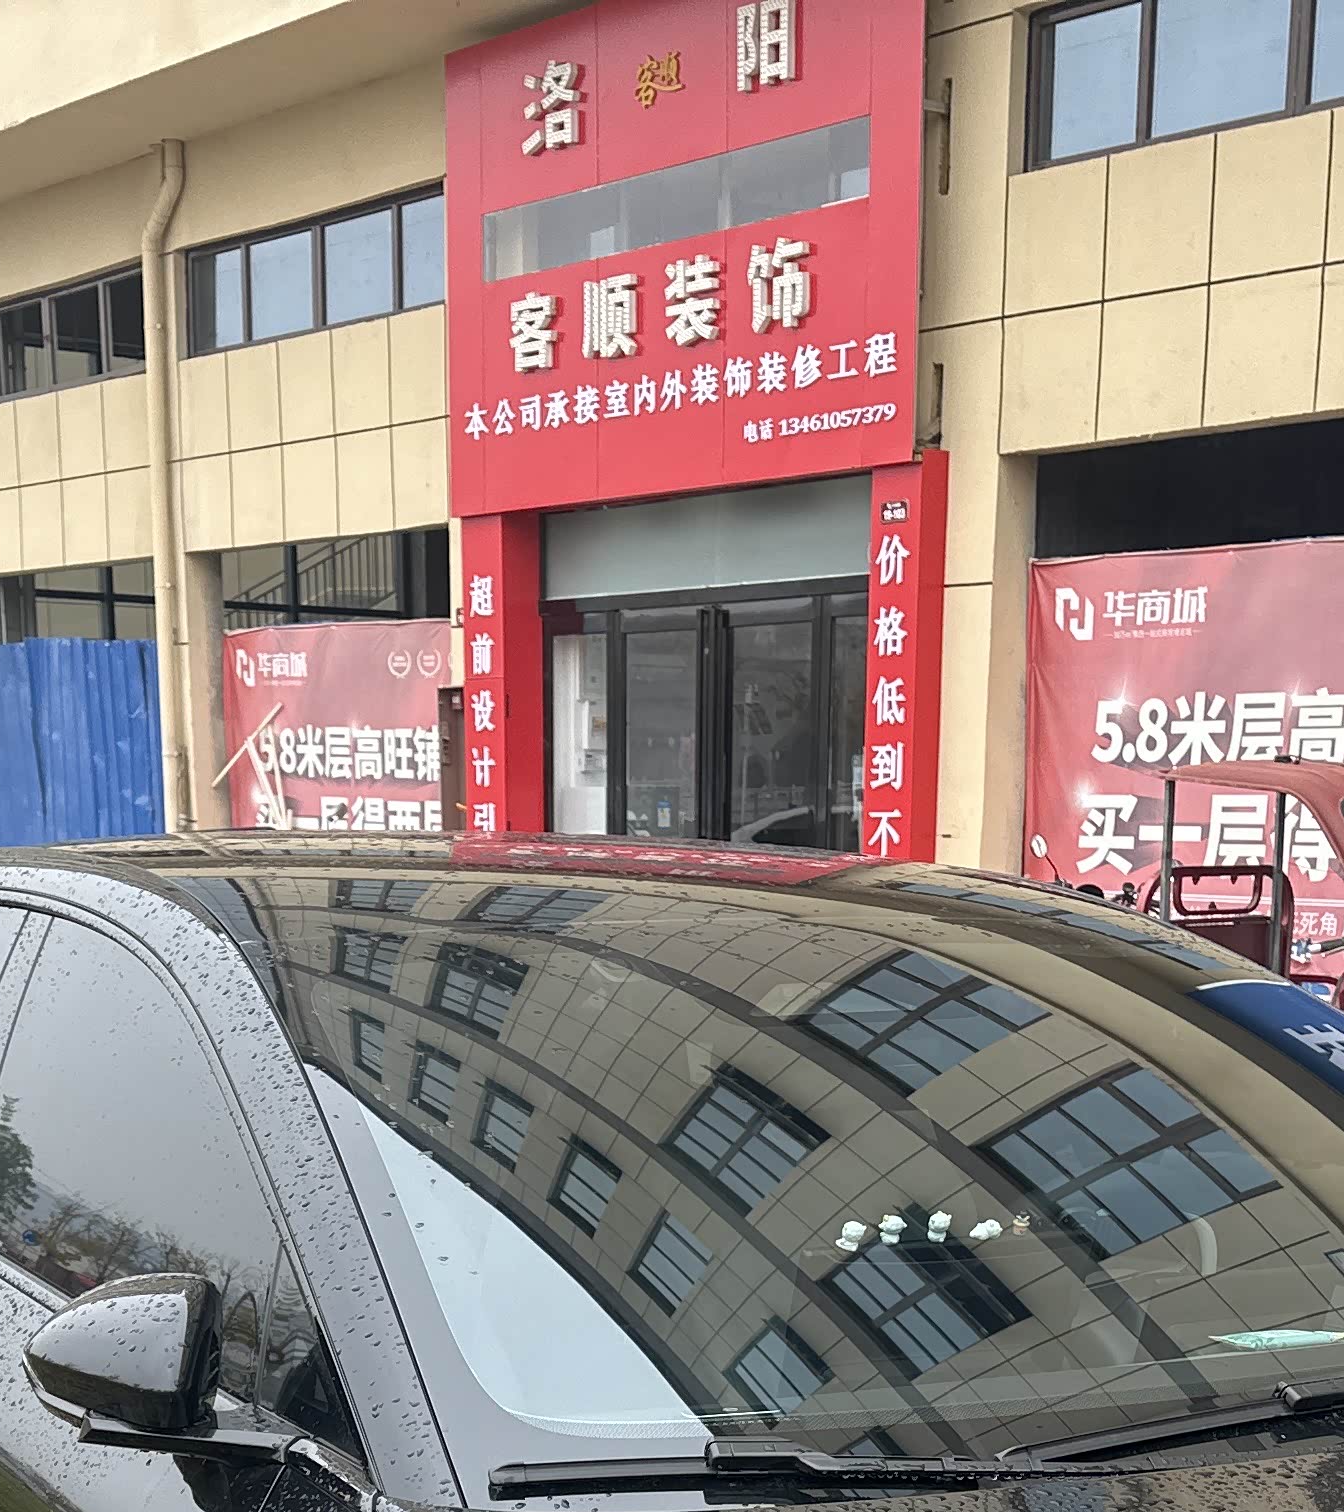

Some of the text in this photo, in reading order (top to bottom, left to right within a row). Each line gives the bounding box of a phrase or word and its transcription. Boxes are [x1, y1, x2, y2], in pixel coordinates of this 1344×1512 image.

[522, 60, 582, 156] 洛
[736, 0, 801, 92] 阳
[509, 237, 811, 374] 客顺装饰
[463, 331, 898, 441] 本公司承接室内外装饰装修工程
[743, 402, 897, 443] 电话 13461057379
[1102, 585, 1209, 627] 华商城
